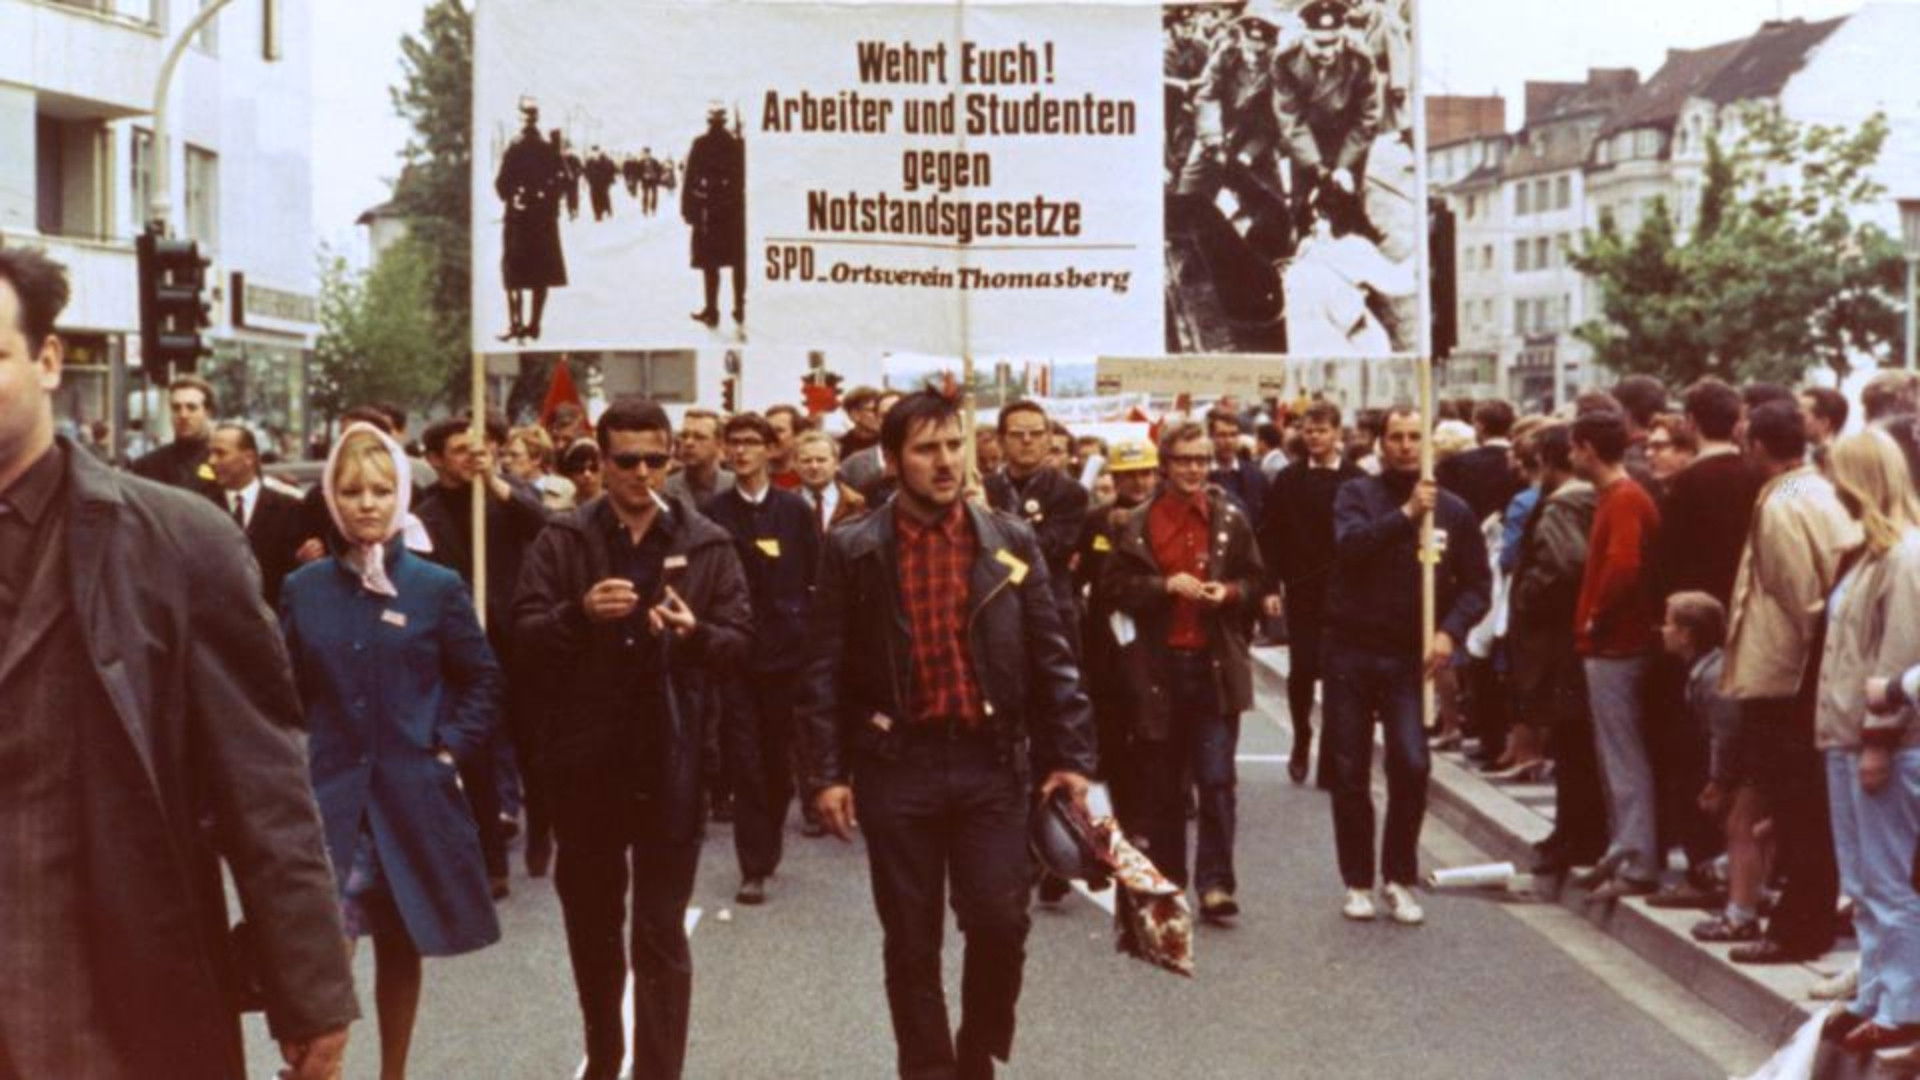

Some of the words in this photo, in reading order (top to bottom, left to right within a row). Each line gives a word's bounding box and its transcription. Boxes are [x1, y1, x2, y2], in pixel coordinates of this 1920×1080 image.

[857, 41, 947, 85] Wehrt
[762, 90, 893, 133] Arbeiter
[904, 93, 955, 135] und
[966, 93, 1136, 136] Studenten
[903, 150, 991, 193] gegen
[807, 191, 1081, 243] Notstandsgesetze
[958, 267, 1131, 292] Thomasberg
